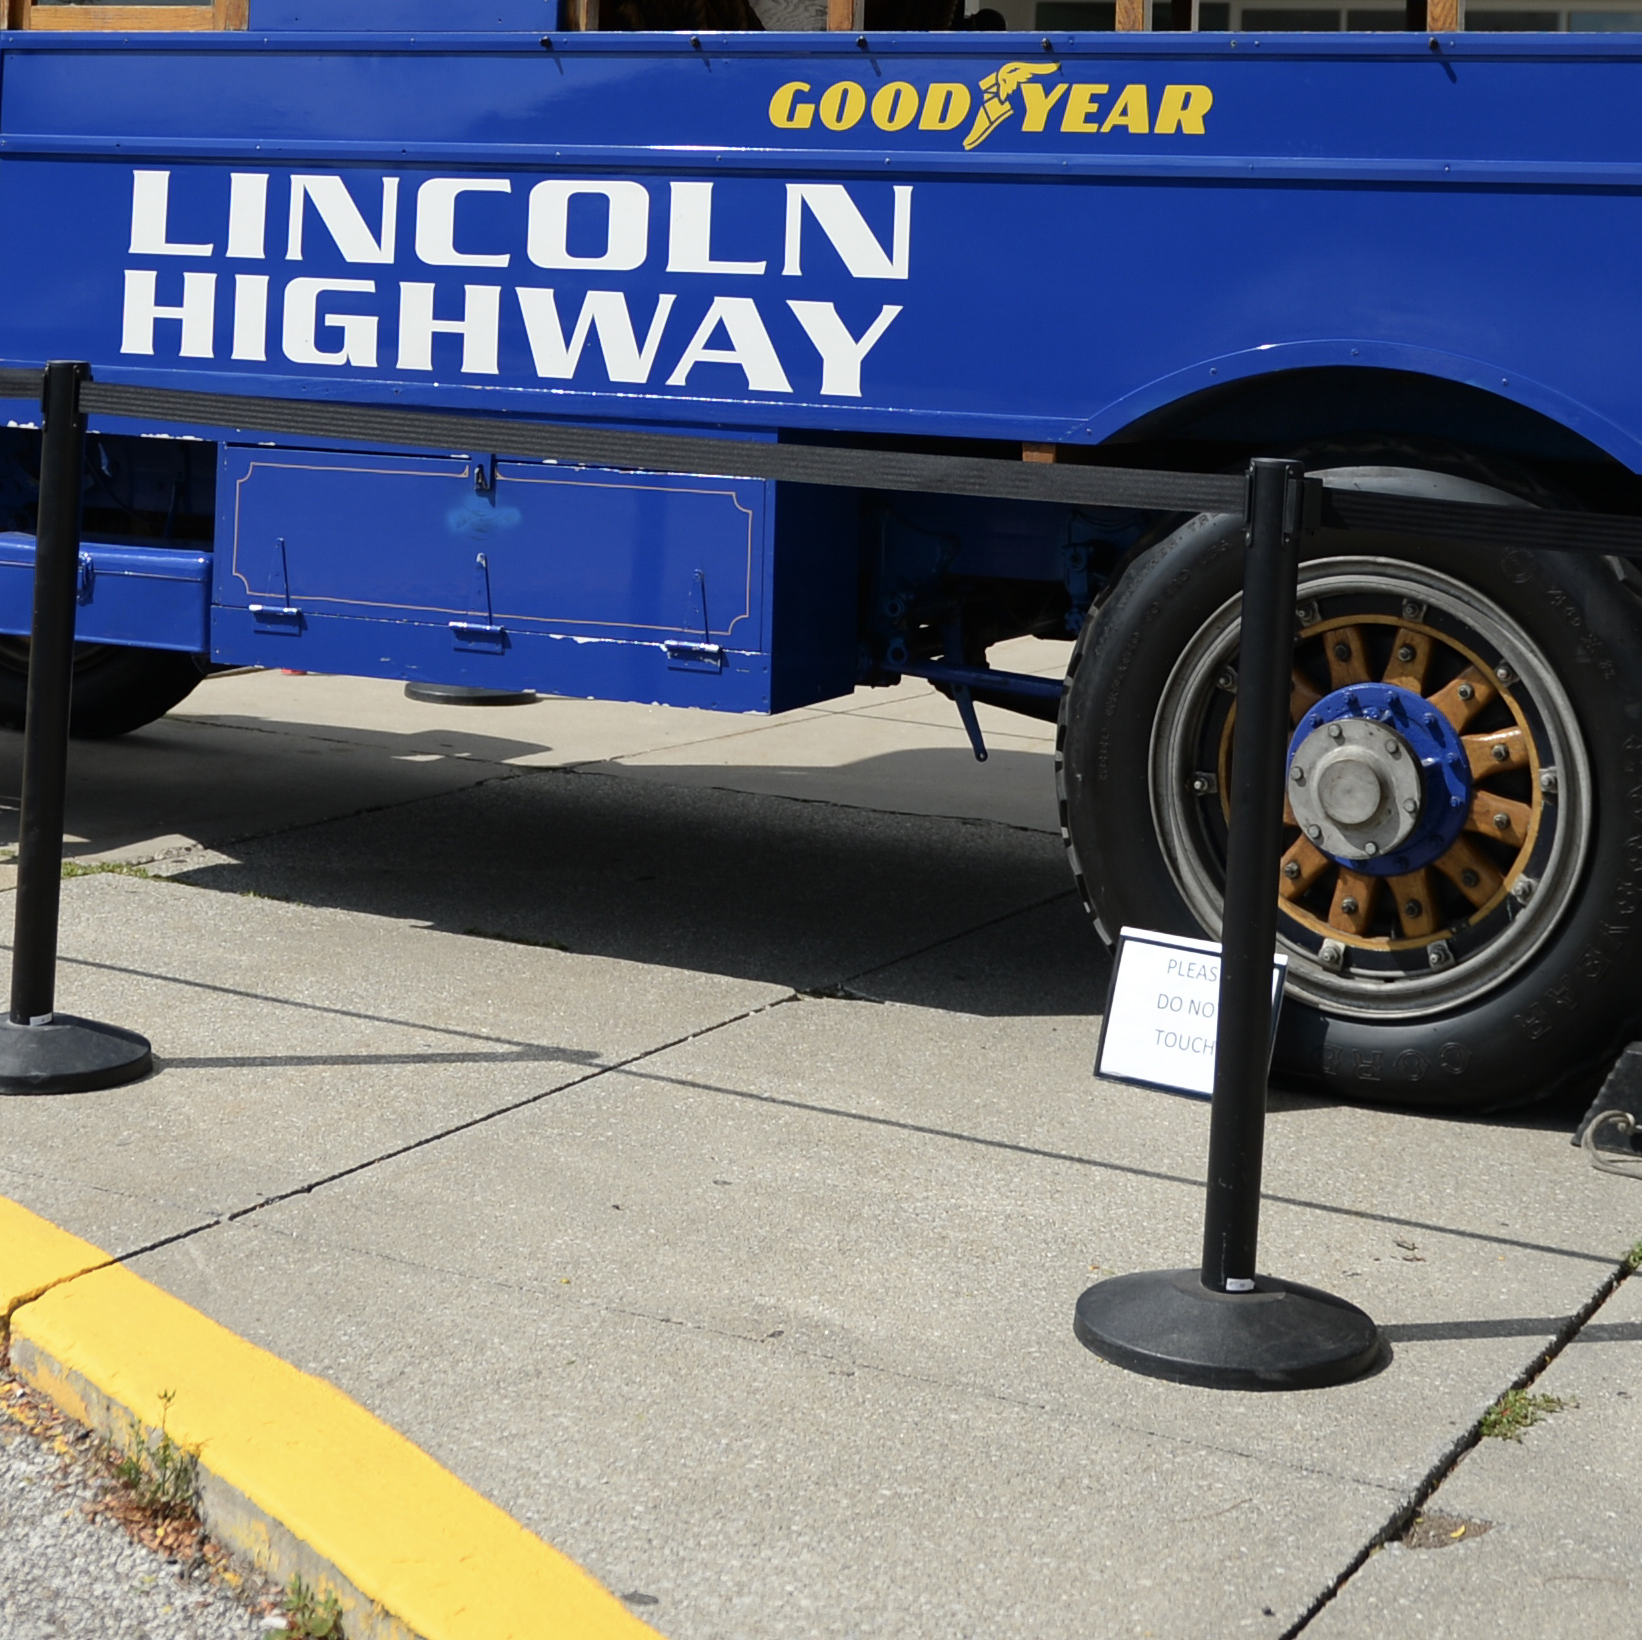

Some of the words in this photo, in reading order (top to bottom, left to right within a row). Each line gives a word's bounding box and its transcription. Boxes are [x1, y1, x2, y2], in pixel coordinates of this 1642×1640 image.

[128, 169, 914, 280] LINCOLN
[119, 270, 904, 398] HIGHWAY
[1166, 957, 1219, 983] PLEAS
[1156, 992, 1184, 1013] DO
[1187, 998, 1216, 1019] NO
[1154, 1027, 1217, 1057] TOUCH
